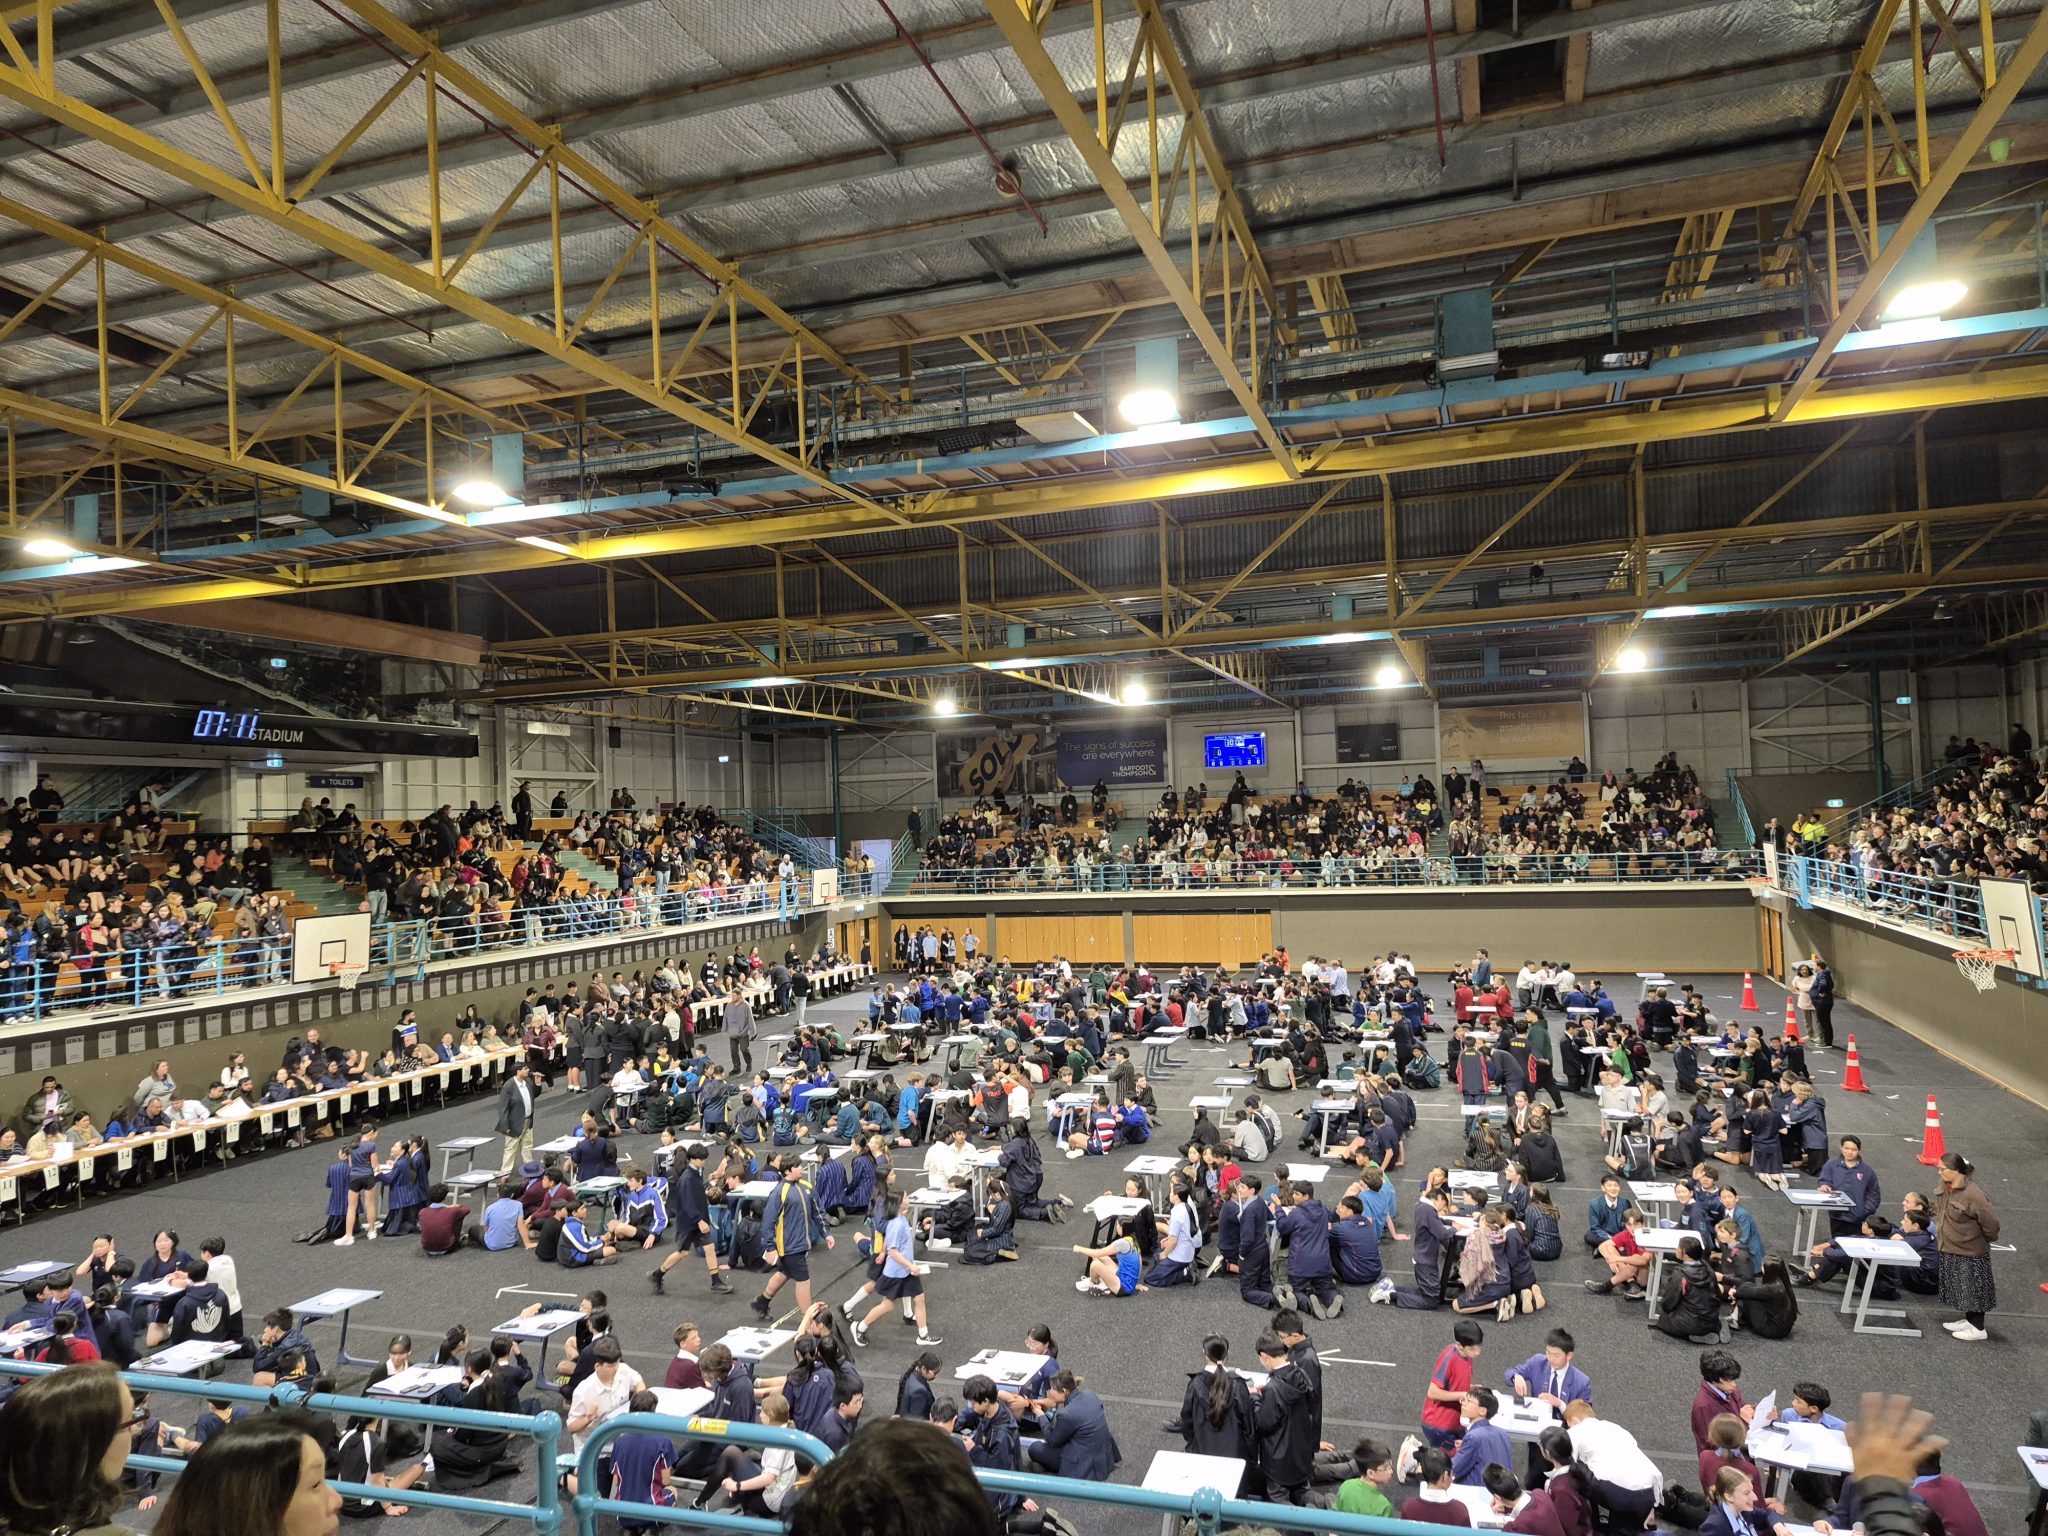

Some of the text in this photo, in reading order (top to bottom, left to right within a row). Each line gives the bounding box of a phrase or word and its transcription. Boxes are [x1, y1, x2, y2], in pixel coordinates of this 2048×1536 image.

[193, 710, 259, 739] 07:11
[251, 728, 304, 743] STADIUM
[1064, 740, 1156, 752] The signs of success
[1082, 752, 1098, 760] are
[1119, 764, 1149, 772] BARFOOT
[329, 778, 354, 786] TOILETS
